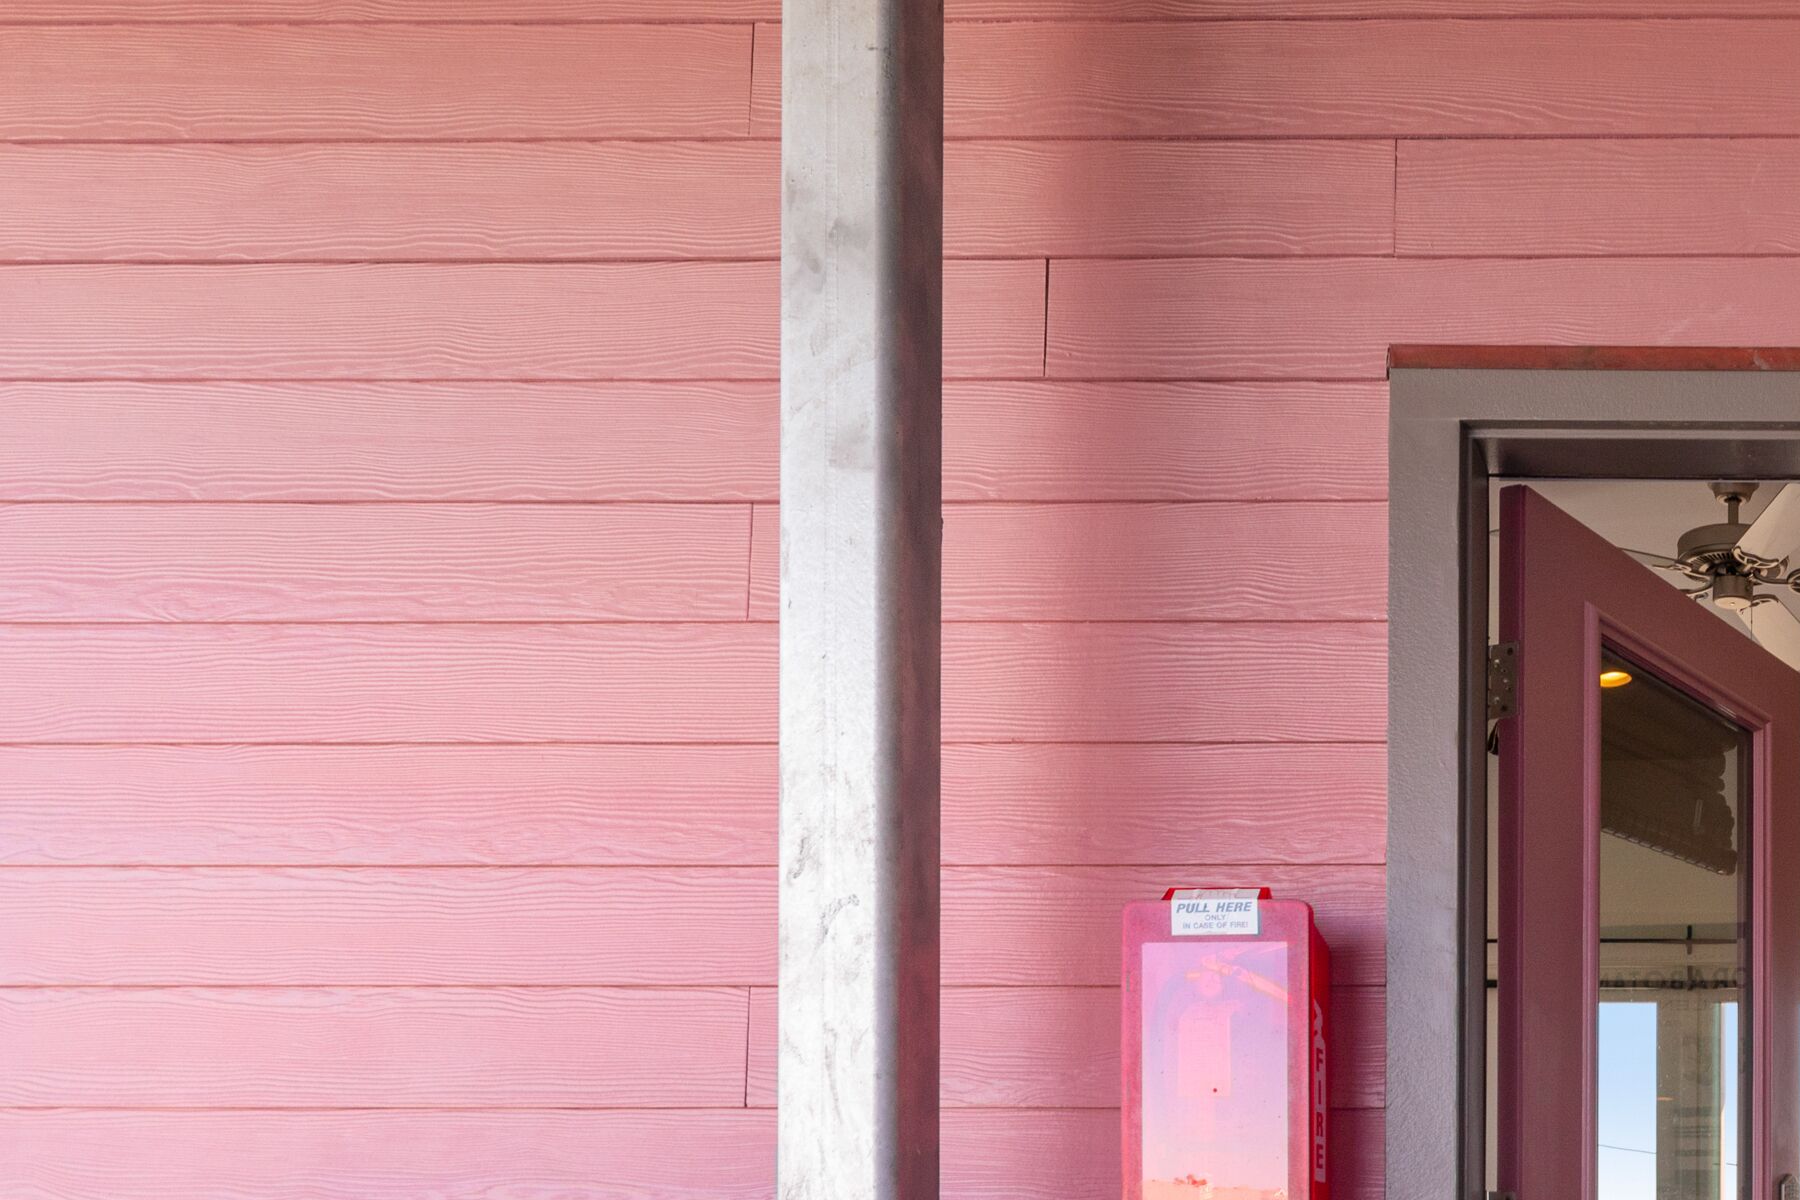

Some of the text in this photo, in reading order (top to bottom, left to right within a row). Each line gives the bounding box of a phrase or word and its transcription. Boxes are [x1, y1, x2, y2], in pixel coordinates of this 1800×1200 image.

[1176, 901, 1252, 914] PULL HERE
[1316, 1048, 1324, 1169] FIRE
